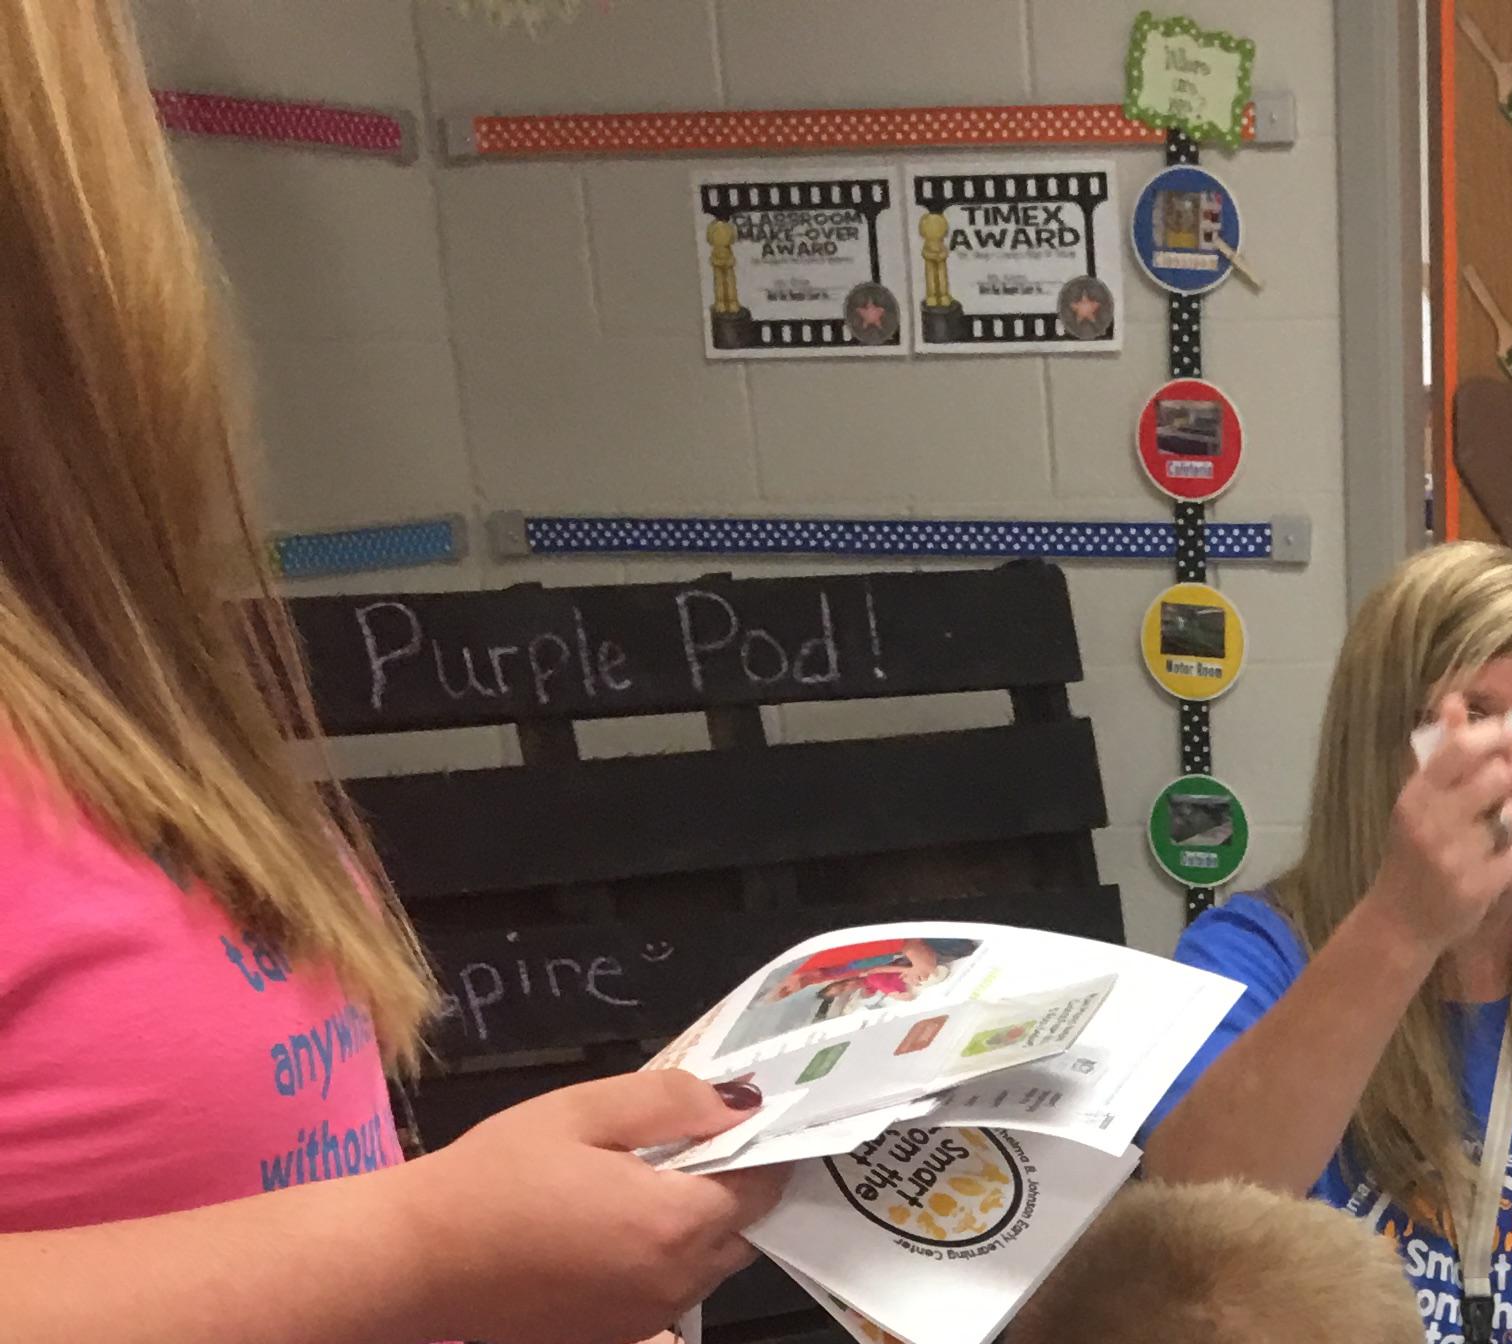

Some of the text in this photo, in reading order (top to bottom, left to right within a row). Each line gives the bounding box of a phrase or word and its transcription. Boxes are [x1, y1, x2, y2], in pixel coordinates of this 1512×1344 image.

[960, 204, 1067, 228] TIMEX
[761, 241, 839, 258] AWARD
[949, 226, 1081, 251] AWARD
[355, 579, 886, 709] Purple Pod!
[855, 1162, 904, 1202] the
[896, 1138, 970, 1208] Smart
[893, 1237, 944, 1261] Center
[948, 1239, 1007, 1261] Learning
